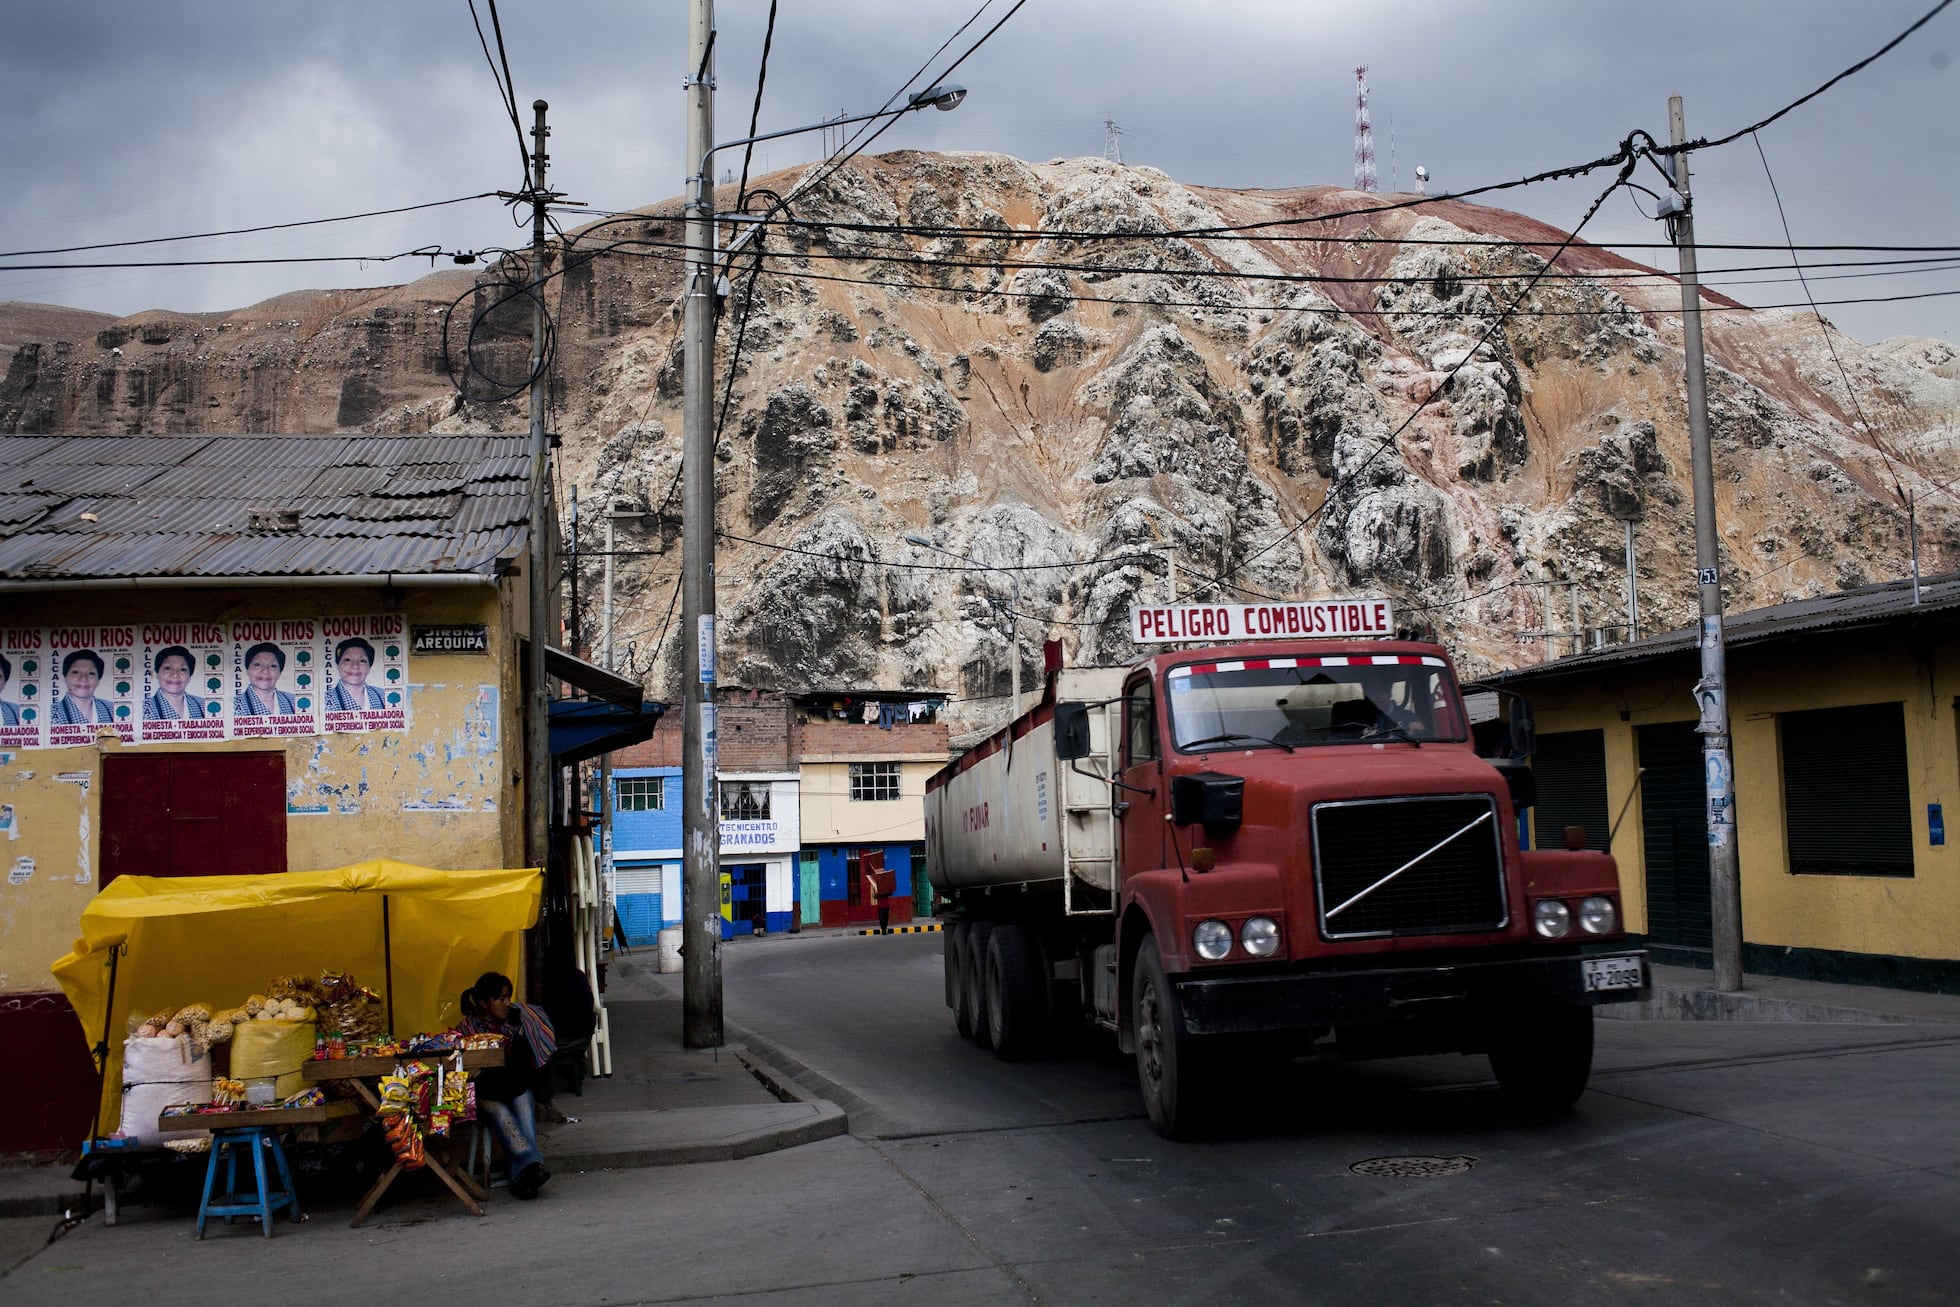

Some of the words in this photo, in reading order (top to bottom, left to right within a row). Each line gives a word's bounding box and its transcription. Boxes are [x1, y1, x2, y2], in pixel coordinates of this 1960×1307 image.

[322, 616, 365, 637] COQUI
[370, 615, 402, 635] RIOS
[1139, 608, 1230, 637] PELIGRO
[1244, 604, 1387, 634] COMBUSTIBLE
[143, 625, 186, 645] COQUI
[192, 624, 224, 643] RIOS
[233, 622, 276, 642] COQUI
[282, 621, 314, 640] RIOS
[7, 628, 42, 649] RIOS
[50, 628, 95, 649] COQUI
[101, 627, 134, 647] RIOS
[416, 637, 484, 649] AREQUIPA
[234, 717, 263, 726] HONESTA
[268, 716, 314, 725] TRABAJADORA
[325, 712, 354, 721] HONESTA
[359, 710, 404, 719] TRABAJADORA
[50, 726, 81, 735] HONESTA
[142, 721, 172, 730] HONESTA
[178, 720, 224, 729] TRABAJADORA
[234, 727, 243, 736] CON
[244, 727, 273, 736] EXPERIENCIA
[278, 726, 298, 734] EMOCION
[299, 725, 315, 734] SOCIAL
[325, 723, 334, 731] CON
[335, 722, 363, 731] EXPERIENCIA
[369, 721, 388, 730] EMOCION
[389, 720, 404, 728] SOCIAL
[50, 736, 60, 745] CON
[61, 736, 91, 745] EXPERIENCIA
[120, 734, 134, 742] OCIAL
[142, 732, 152, 740] CON
[153, 731, 182, 740] EXPERIENCIA
[183, 731, 187, 739] Y
[187, 731, 208, 739] EMOCION
[209, 730, 224, 739] SOCIAL
[23, 737, 39, 746] SOCIAL
[720, 822, 778, 831] TECNICENTRO
[720, 833, 775, 845] GRANADOS
